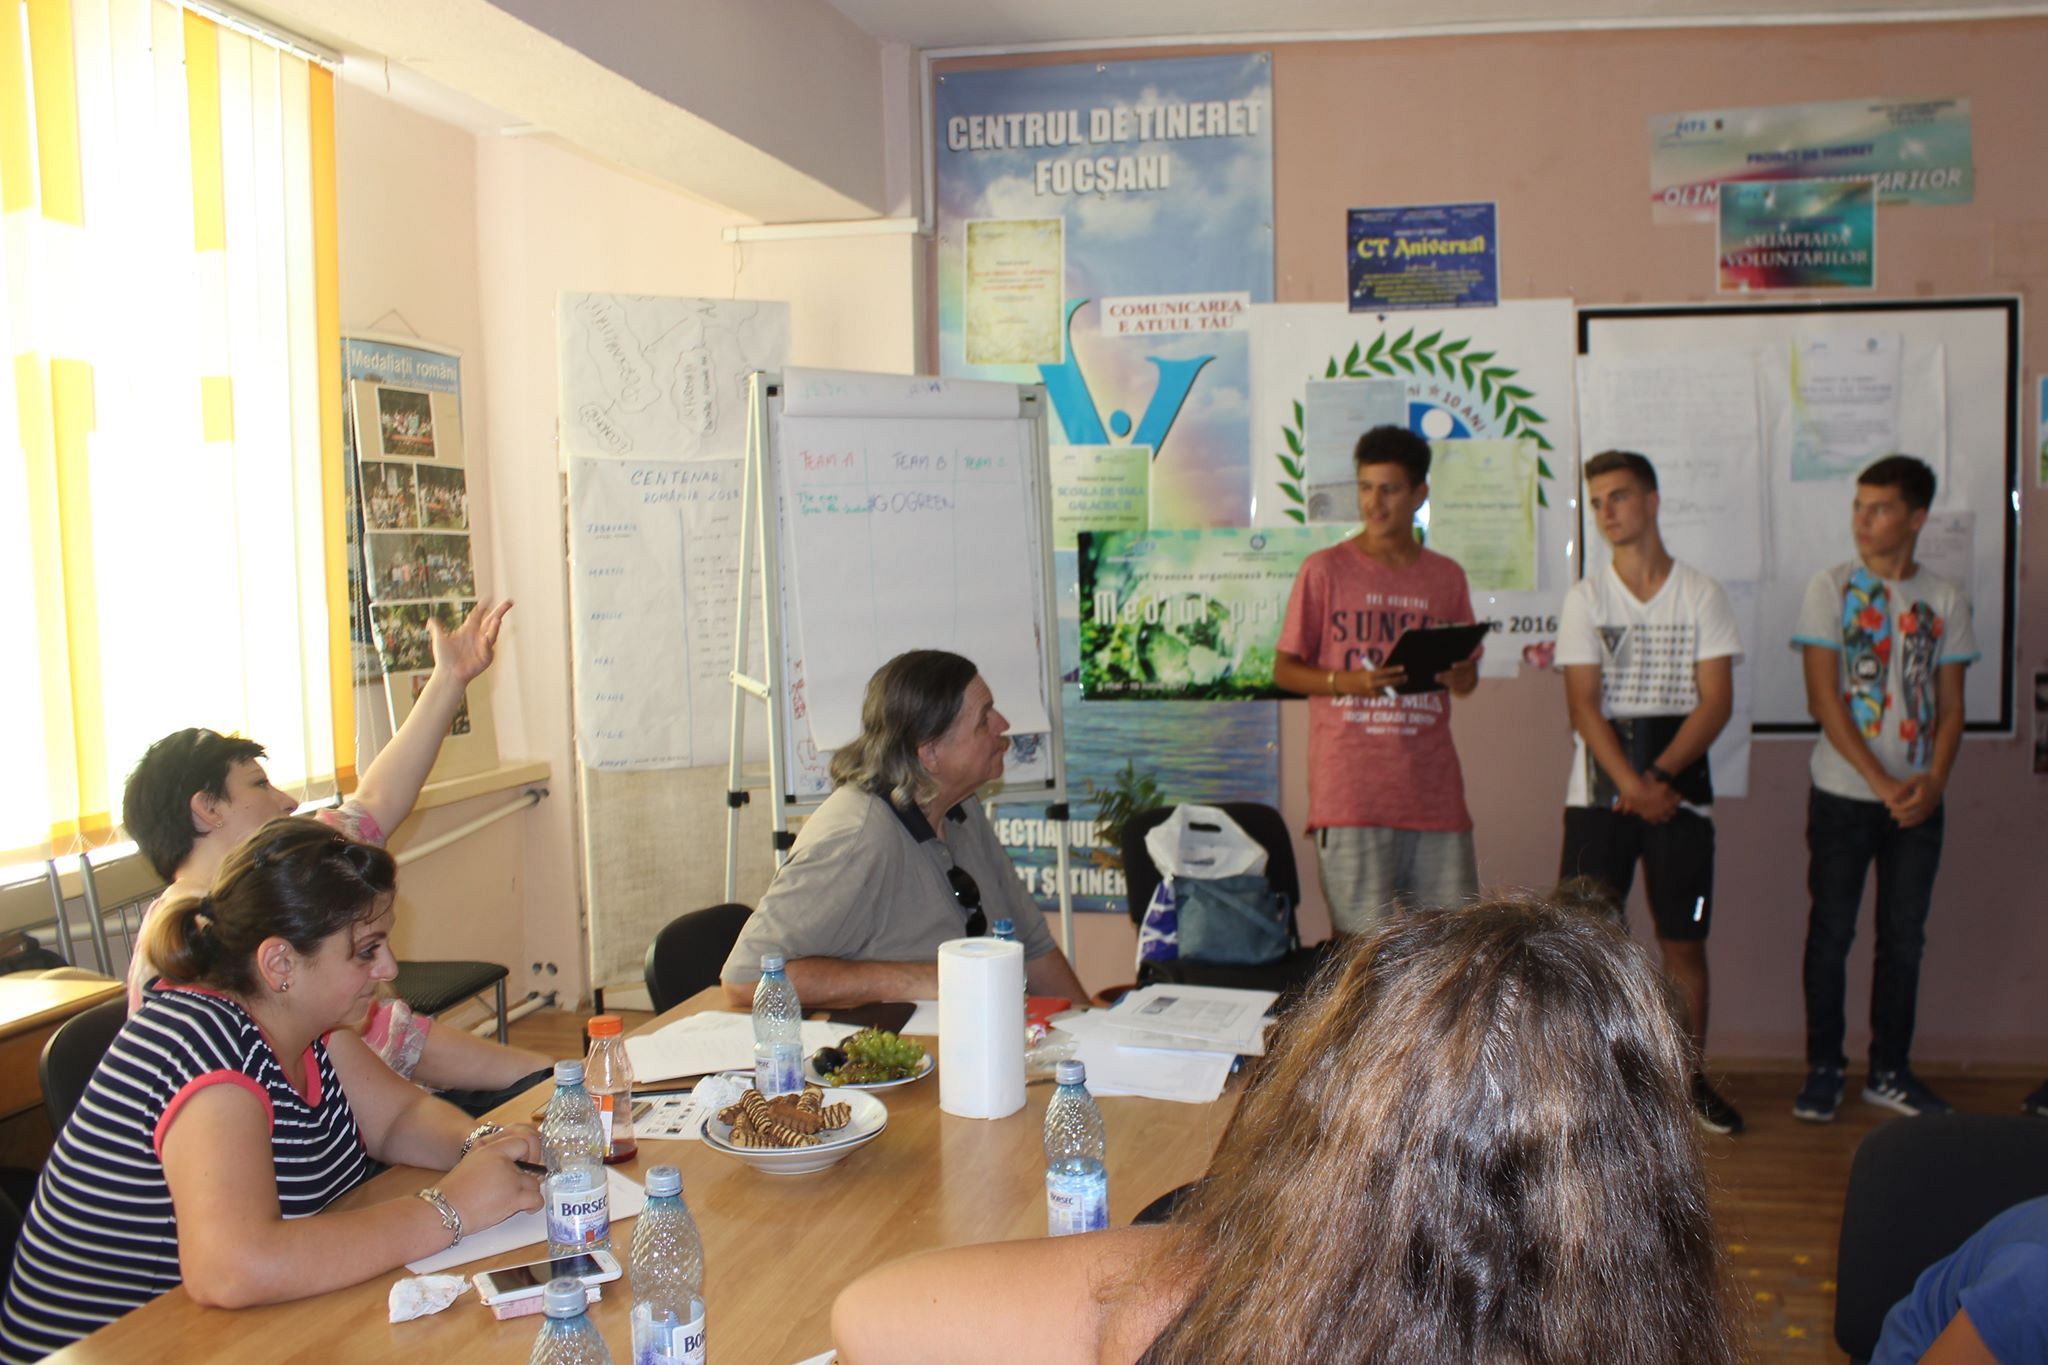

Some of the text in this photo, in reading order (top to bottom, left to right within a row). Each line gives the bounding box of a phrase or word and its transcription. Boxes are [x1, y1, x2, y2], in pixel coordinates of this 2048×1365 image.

[948, 101, 1262, 151] CENTRUL DE TINERET
[1357, 238, 1390, 258] CT
[1744, 231, 1850, 248] OLIMPIADA
[1722, 250, 1868, 267] VOLUNTARILOR
[1109, 299, 1242, 317] COMUNICAREA
[1120, 320, 1129, 332] E
[1135, 319, 1192, 331] ATUUL
[1443, 391, 1462, 409] 10
[1461, 406, 1487, 432] ANI
[800, 450, 837, 471] TEAM
[892, 451, 929, 471] TEAM
[1094, 590, 1209, 625] Mediul
[1510, 615, 1558, 633] 2016
[561, 1195, 608, 1216] BORSEC
